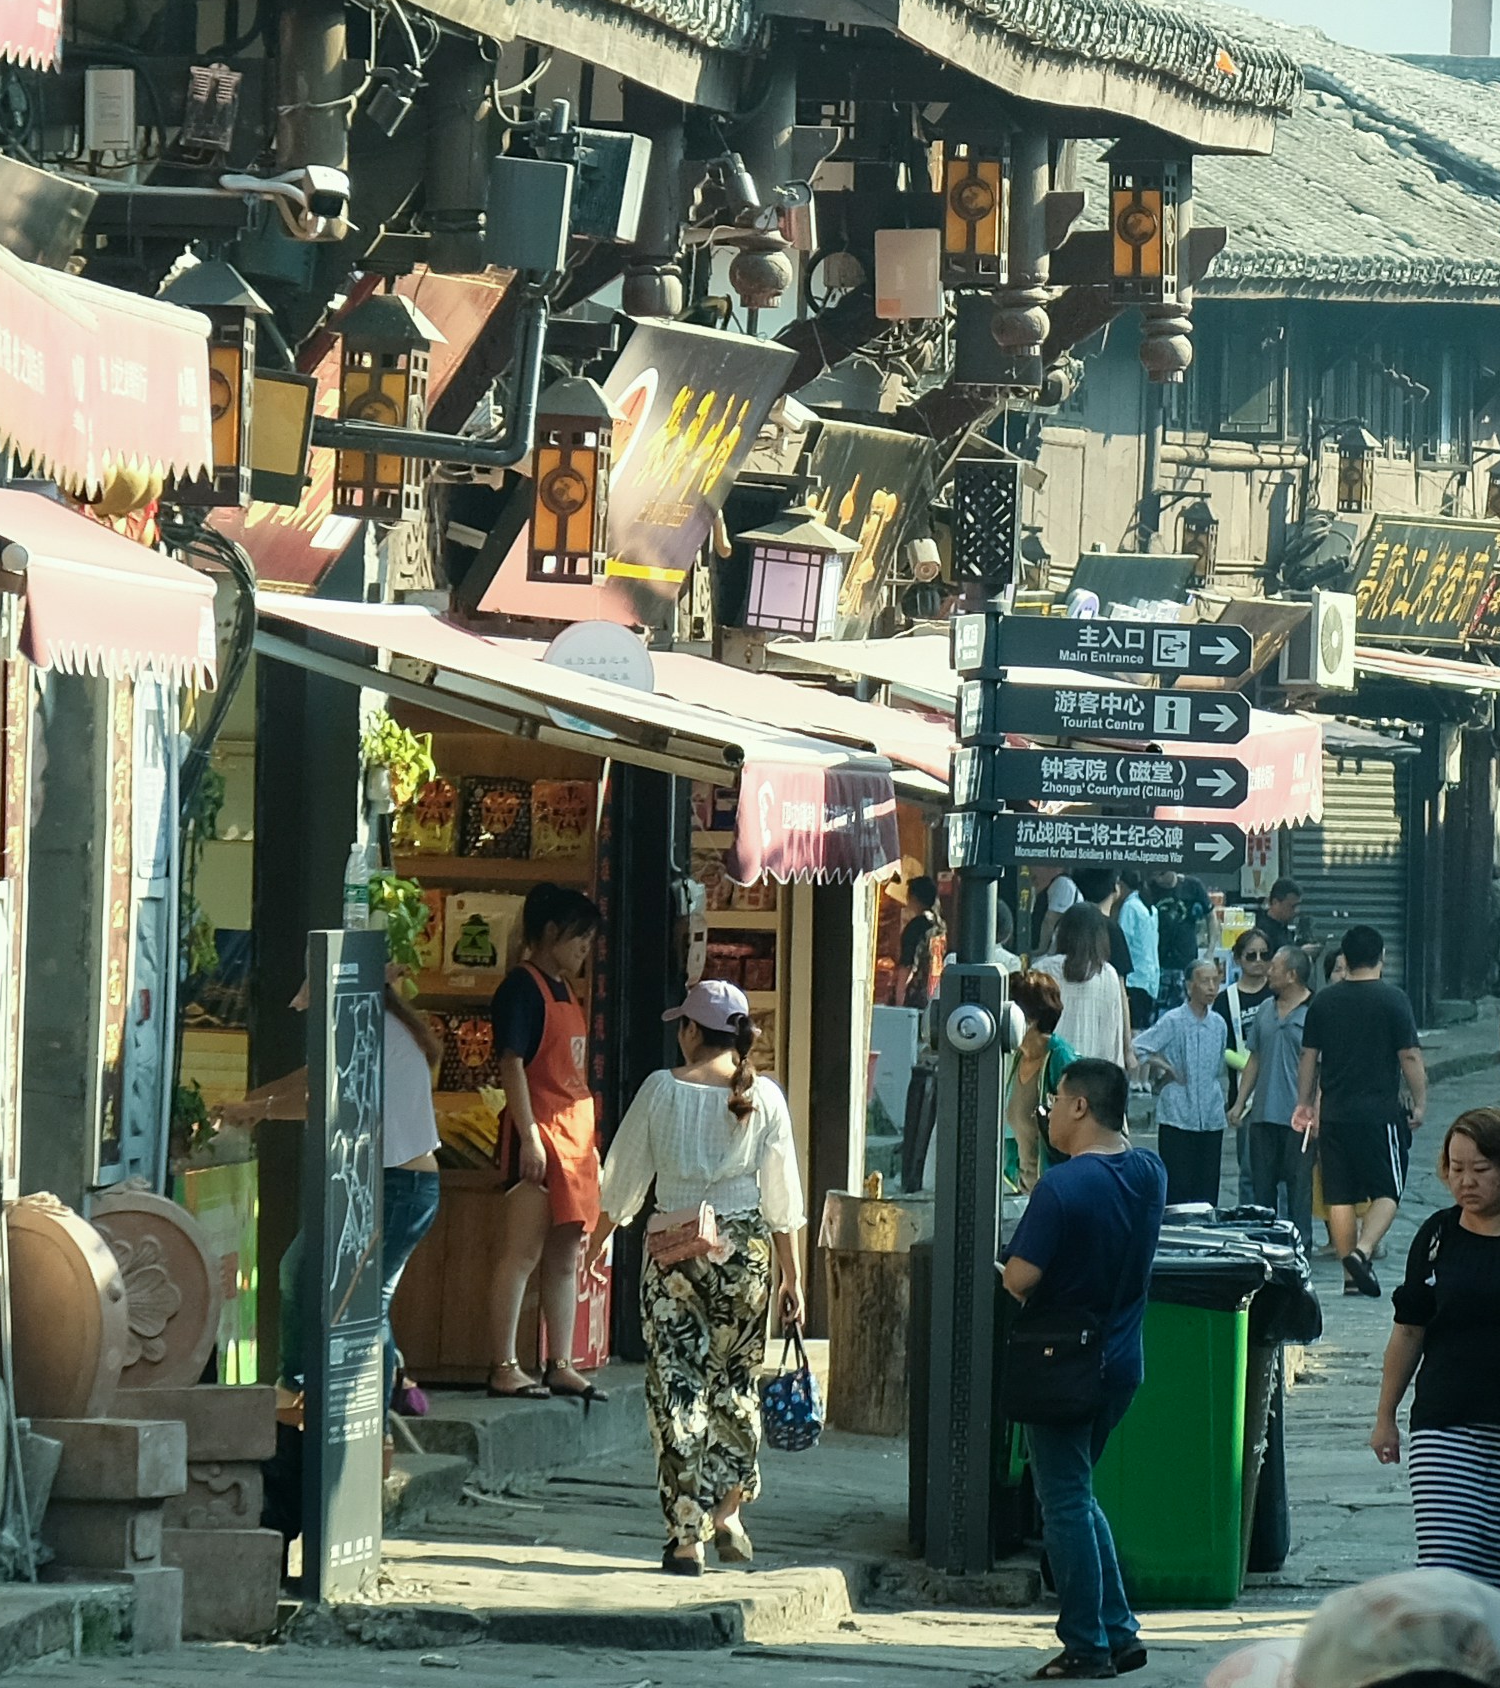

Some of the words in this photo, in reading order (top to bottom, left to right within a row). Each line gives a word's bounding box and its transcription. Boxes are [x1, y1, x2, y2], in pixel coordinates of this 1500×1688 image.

[1077, 625, 1145, 650] 主入口
[1059, 649, 1087, 662] Main
[1090, 650, 1144, 664] Entrance
[1054, 690, 1145, 716] 游客中心
[1061, 716, 1103, 730] Tourist
[1105, 718, 1145, 731] Centre
[1042, 781, 1085, 796] Zhongs'
[1087, 783, 1140, 798] Courtyard
[1142, 785, 1184, 800] (Citang)
[1017, 819, 1183, 849] 抗战阵亡将士纪念碑
[1015, 846, 1049, 858] Monument
[1050, 847, 1059, 858] for
[1060, 848, 1078, 858] Dead
[1105, 849, 1112, 859] in
[1112, 849, 1123, 861] the
[1169, 852, 1183, 863] War
